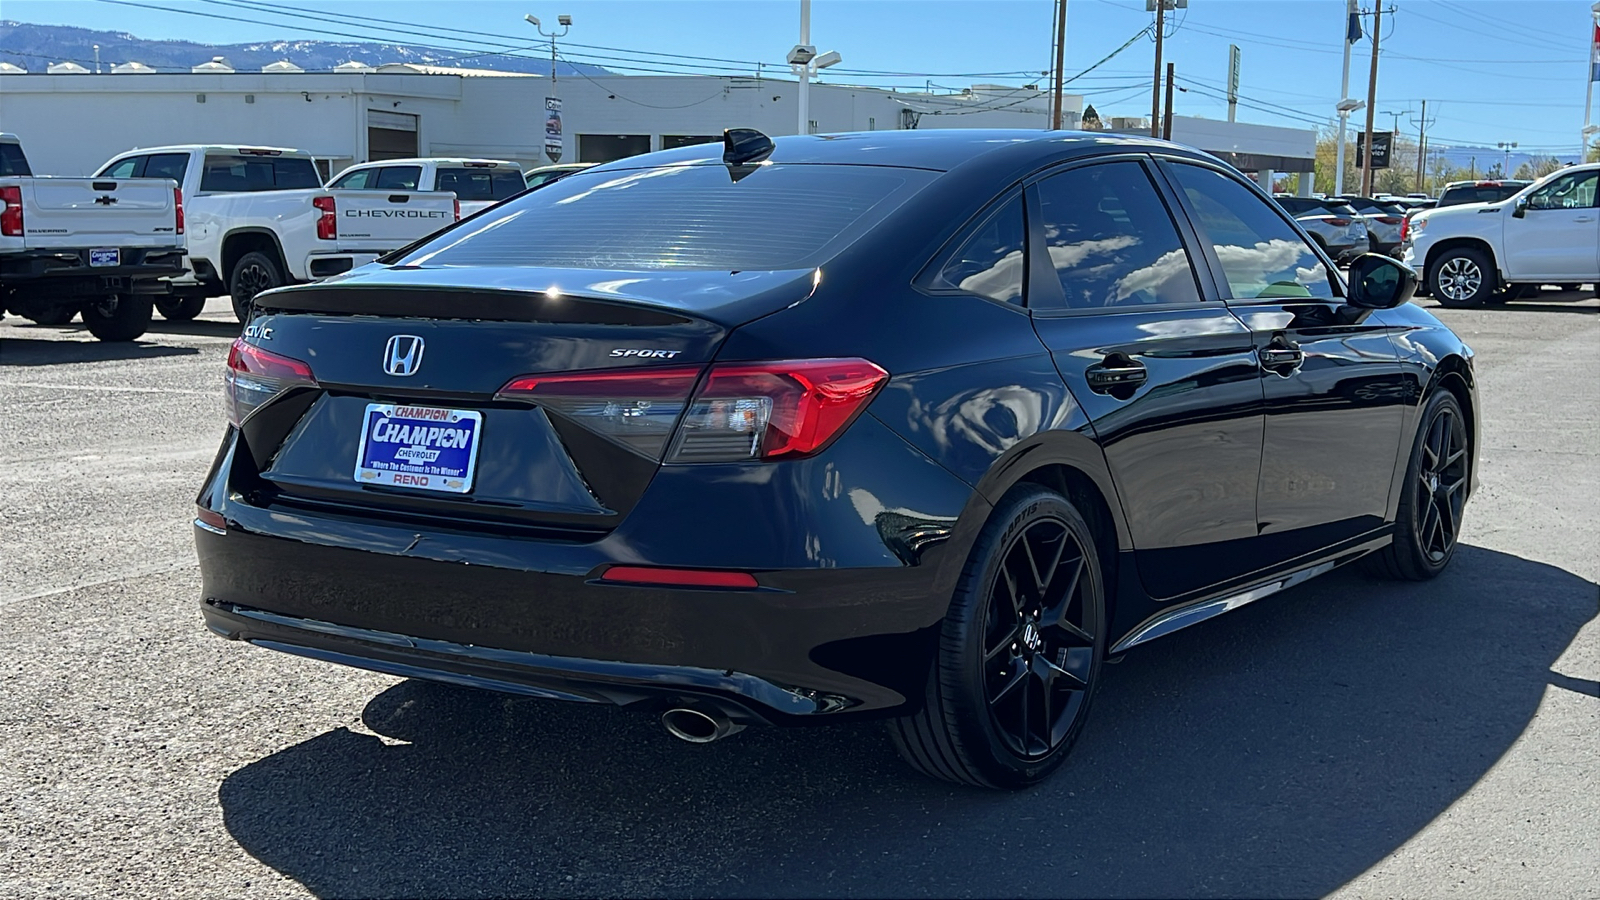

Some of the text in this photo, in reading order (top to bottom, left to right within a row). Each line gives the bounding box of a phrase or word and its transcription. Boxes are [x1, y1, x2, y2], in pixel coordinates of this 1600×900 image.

[345, 209, 448, 219] CHEVROLET
[244, 325, 273, 341] CIVIC
[609, 348, 682, 359] SPORT
[395, 407, 449, 420] CHAMPION
[372, 417, 470, 449] CHAMPION
[398, 449, 436, 459] CHEVROLET
[389, 462, 399, 471] The
[400, 463, 424, 473] Customer
[430, 466, 440, 475] The
[393, 474, 429, 486] RENO
